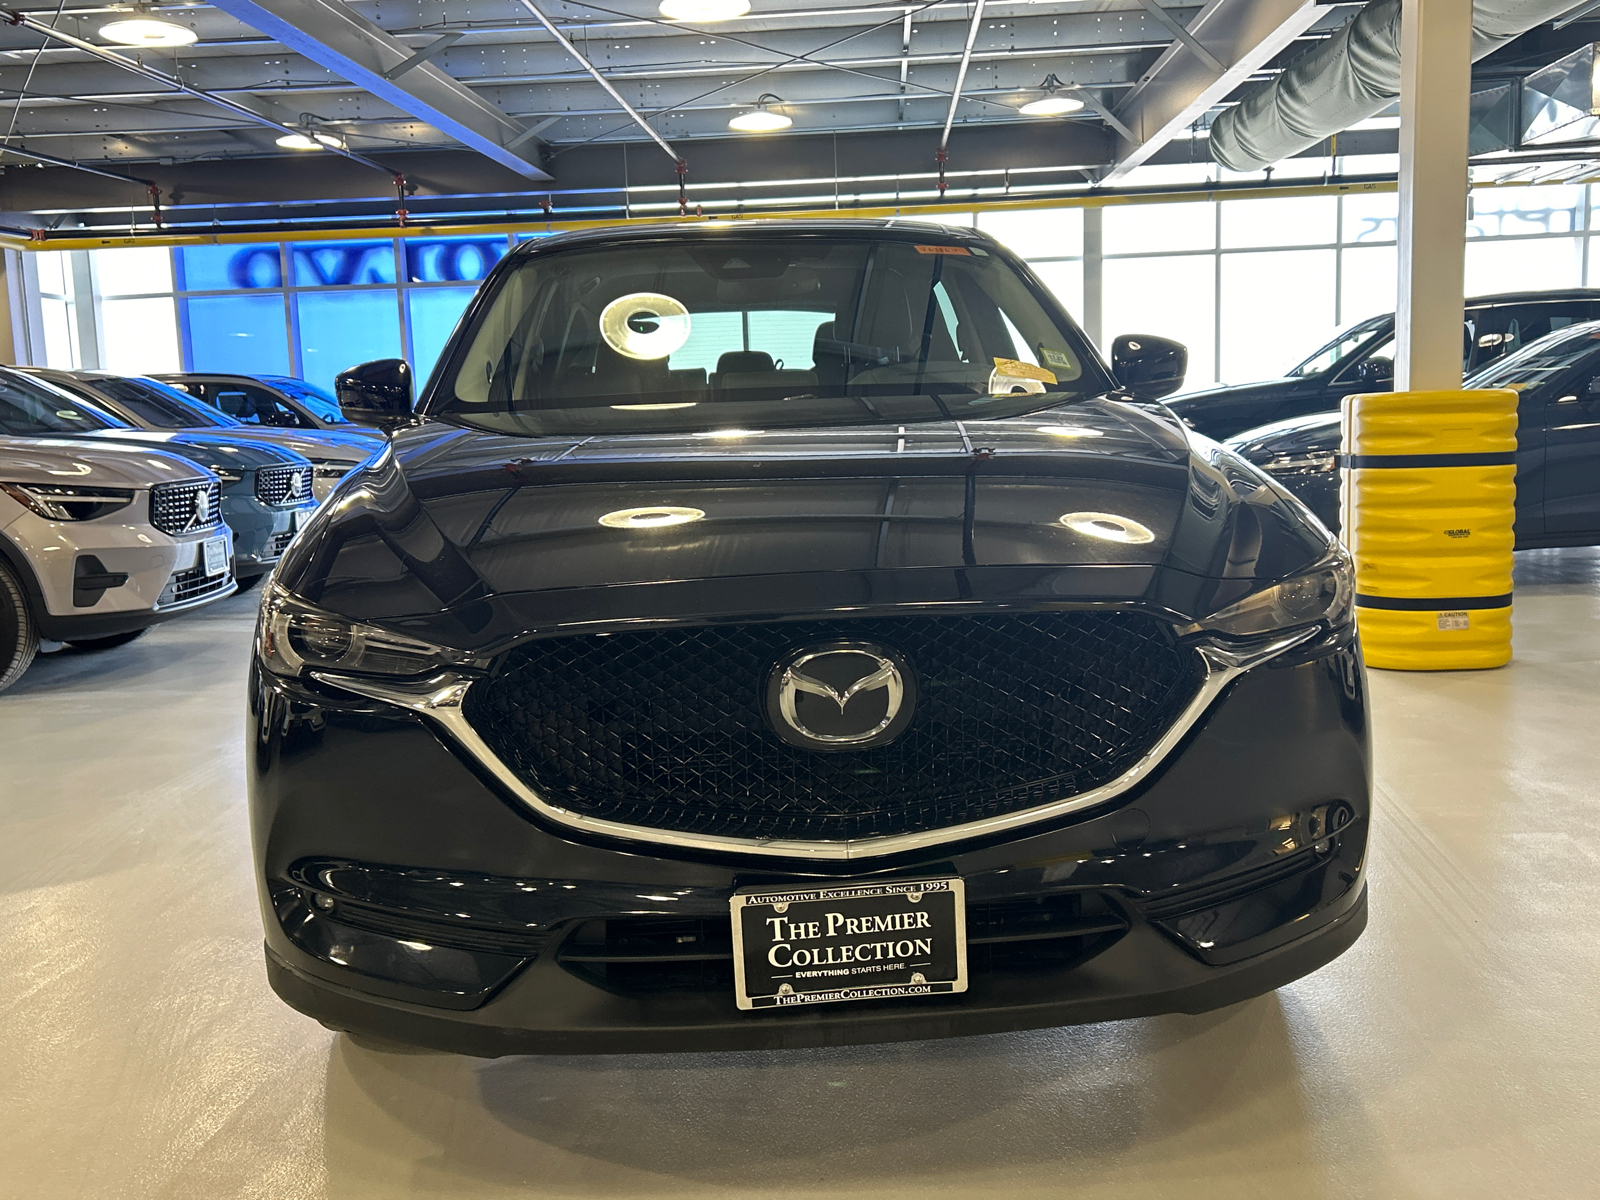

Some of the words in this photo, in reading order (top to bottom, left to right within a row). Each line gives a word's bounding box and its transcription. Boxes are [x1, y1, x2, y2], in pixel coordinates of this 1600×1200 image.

[748, 892, 816, 904] AUTOMOTIVE
[820, 888, 883, 899] EXCELLENCE
[886, 885, 916, 894] SINCE
[920, 882, 947, 891] 1995
[766, 916, 821, 941] THE
[825, 911, 931, 937] PREMIER
[768, 938, 932, 967] COLLECTION
[795, 969, 849, 978] EVERYTHING
[851, 966, 882, 974] STARTS
[774, 985, 931, 1005] THEPREMIERCOLLECTION.COM
